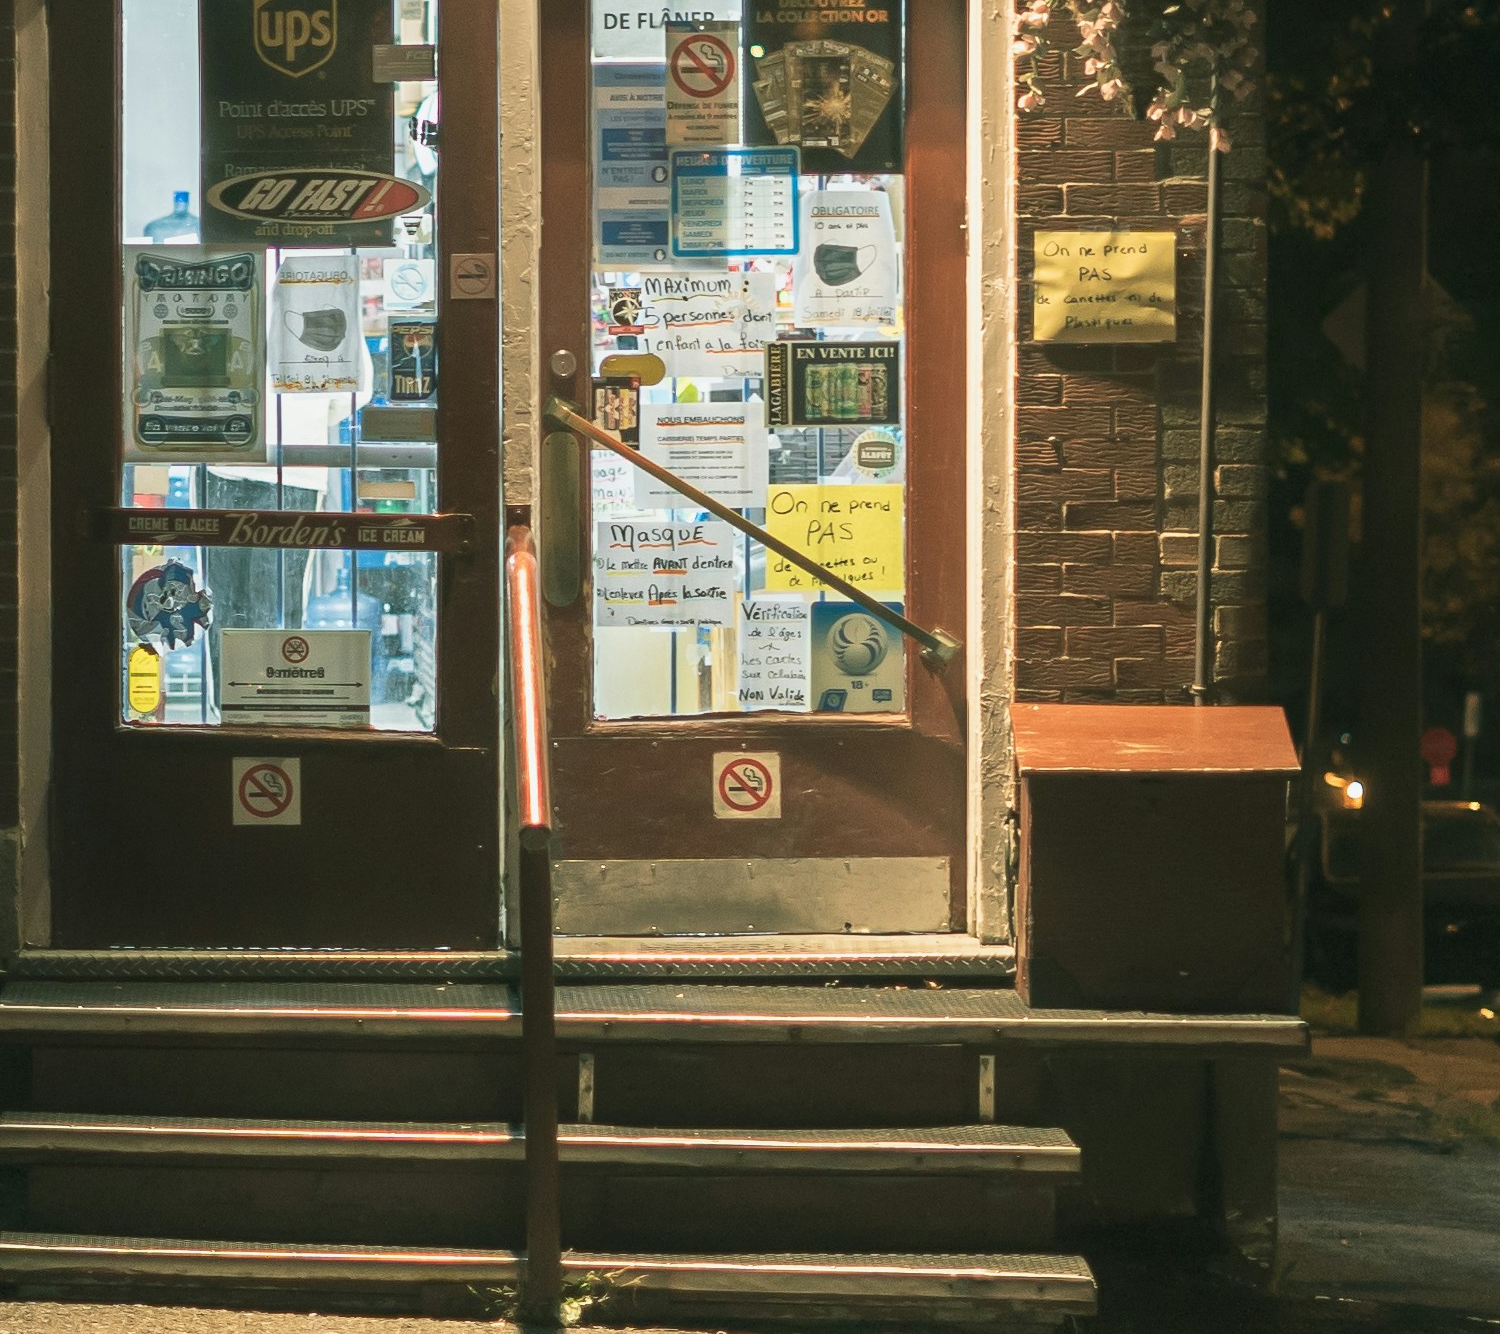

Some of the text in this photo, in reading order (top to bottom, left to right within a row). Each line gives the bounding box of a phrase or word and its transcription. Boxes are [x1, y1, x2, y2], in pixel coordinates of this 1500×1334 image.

[604, 12, 630, 30] DE
[776, 11, 861, 23] COLLECTION
[863, 10, 889, 24] OR
[260, 9, 332, 62] ups
[218, 100, 262, 117] Point
[268, 99, 327, 117] d'accès
[238, 178, 298, 210] GO
[811, 205, 880, 216] OBLIGATOIRE
[254, 223, 279, 237] and
[1043, 241, 1148, 257] On ne prend
[1079, 266, 1113, 281] PAS
[1036, 295, 1051, 305] de
[640, 306, 773, 330] 5 personnes dont
[391, 325, 434, 334] PEPSI
[656, 334, 701, 352] enfant
[719, 339, 733, 350] la
[739, 331, 765, 349] fois
[796, 347, 895, 359] EN VENTE ICI!
[394, 374, 431, 394] TIRZ
[772, 491, 890, 514] On ne prend
[225, 513, 346, 546] Borden's
[357, 528, 425, 544] ICE CREAM
[807, 519, 854, 546] PAS
[653, 557, 688, 570] AVANT
[774, 557, 791, 573] de
[819, 556, 855, 569] nettes
[741, 602, 807, 621] Vérification
[748, 627, 761, 638] de
[741, 653, 761, 666] Les
[769, 685, 805, 702] Valide
